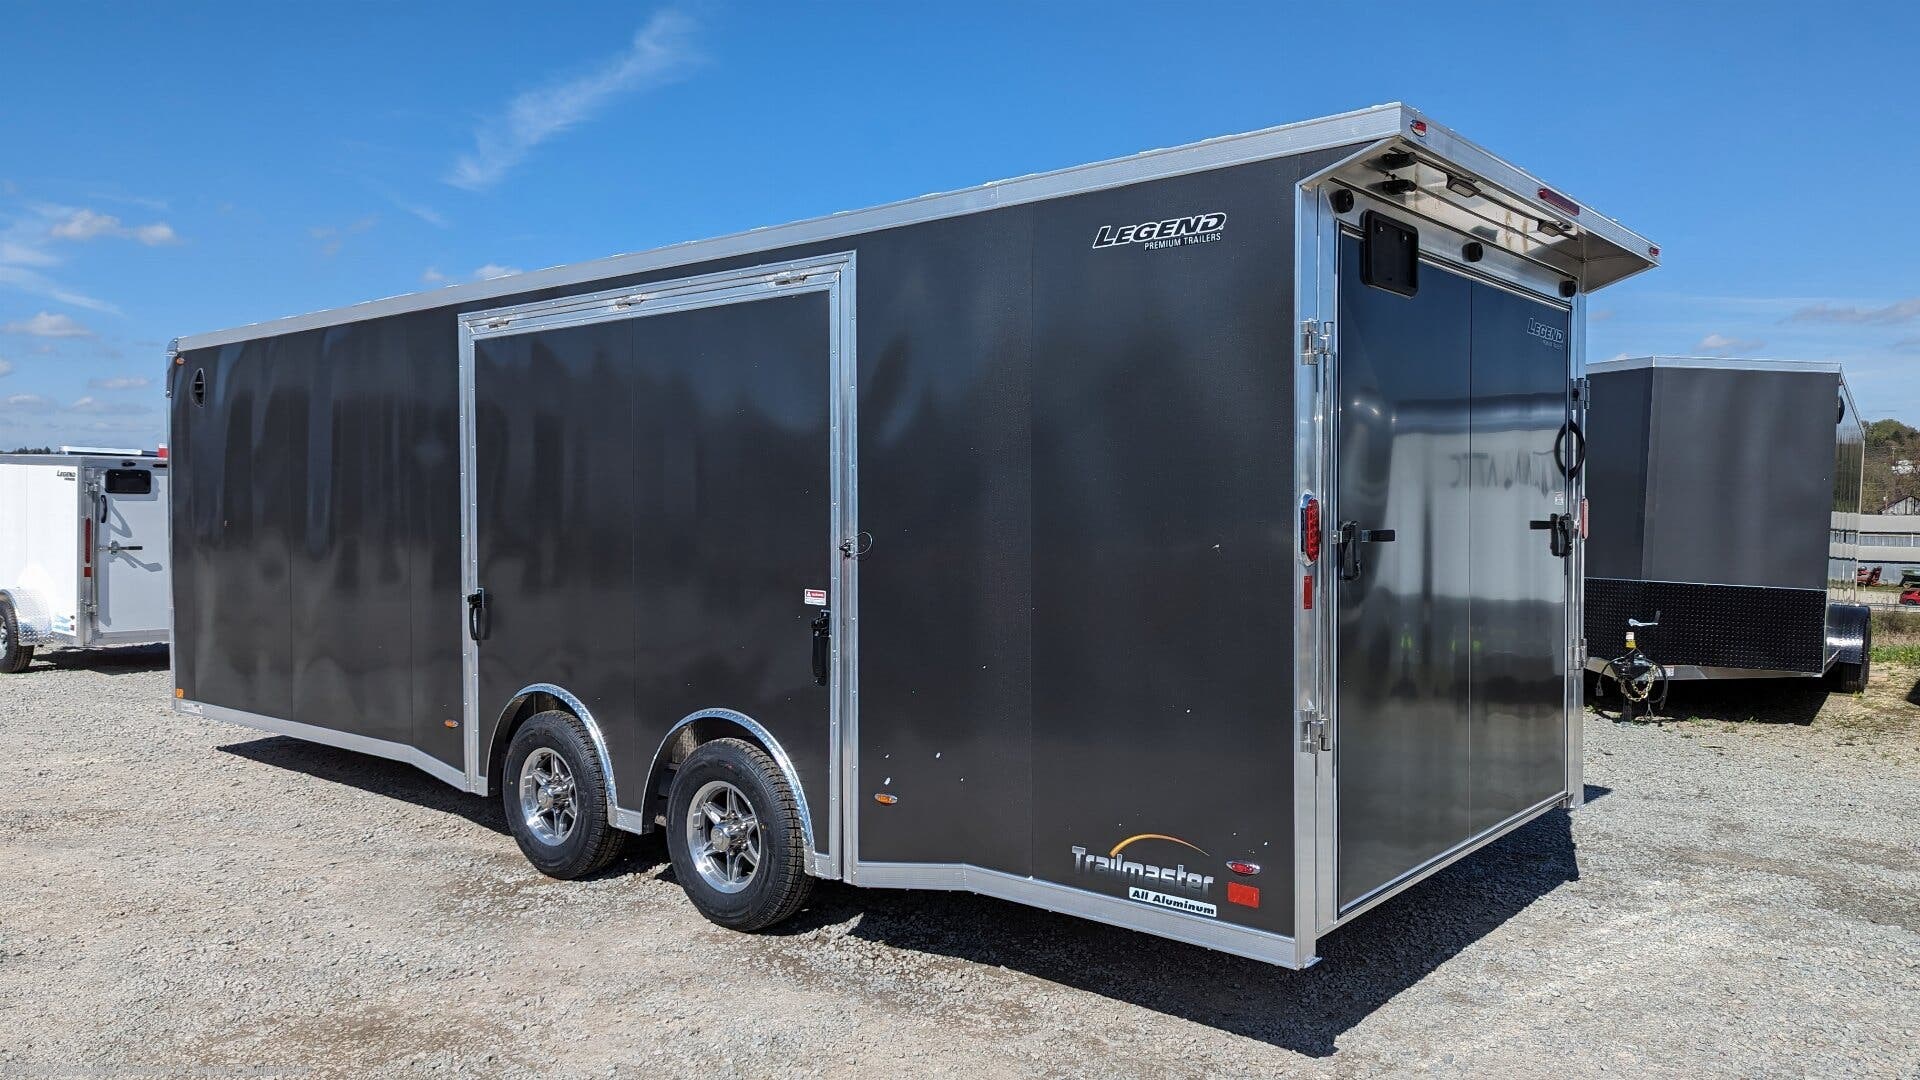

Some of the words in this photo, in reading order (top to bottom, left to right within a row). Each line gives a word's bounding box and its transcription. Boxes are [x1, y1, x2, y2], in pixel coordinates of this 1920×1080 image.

[1092, 212, 1227, 249] LEGEND
[1144, 239, 1181, 251] PREMIUM
[1184, 232, 1221, 245] TRAILERS
[1527, 318, 1564, 343] LEGEND
[1071, 845, 1215, 899] Trailmaster
[1132, 889, 1149, 901] All
[1152, 894, 1215, 915] Aluminum
